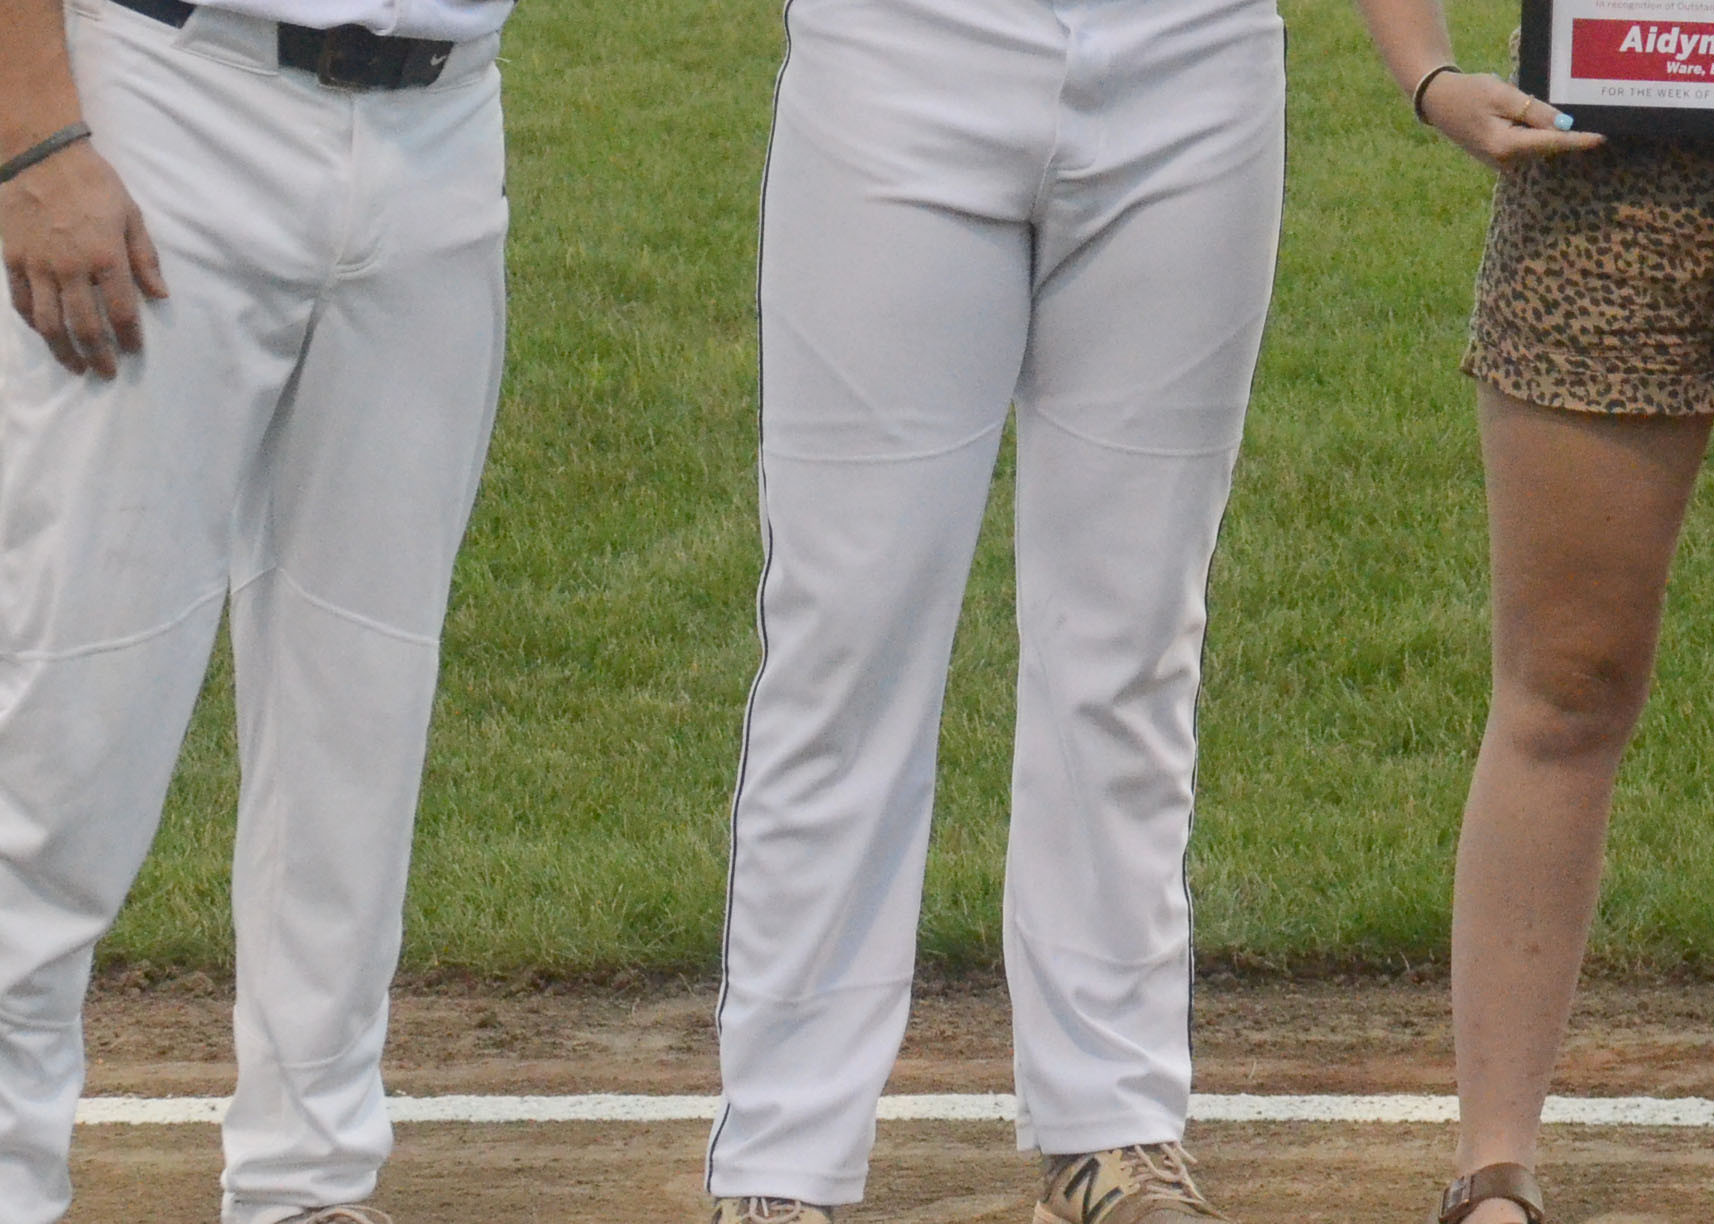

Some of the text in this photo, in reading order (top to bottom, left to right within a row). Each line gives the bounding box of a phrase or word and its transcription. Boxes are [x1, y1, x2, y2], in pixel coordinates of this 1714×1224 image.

[1666, 60, 1706, 76] Ware,
[1601, 86, 1625, 97] FOR
[1630, 87, 1653, 98] THE
[1657, 88, 1690, 99] WEEK
[1695, 89, 1711, 100] OF
